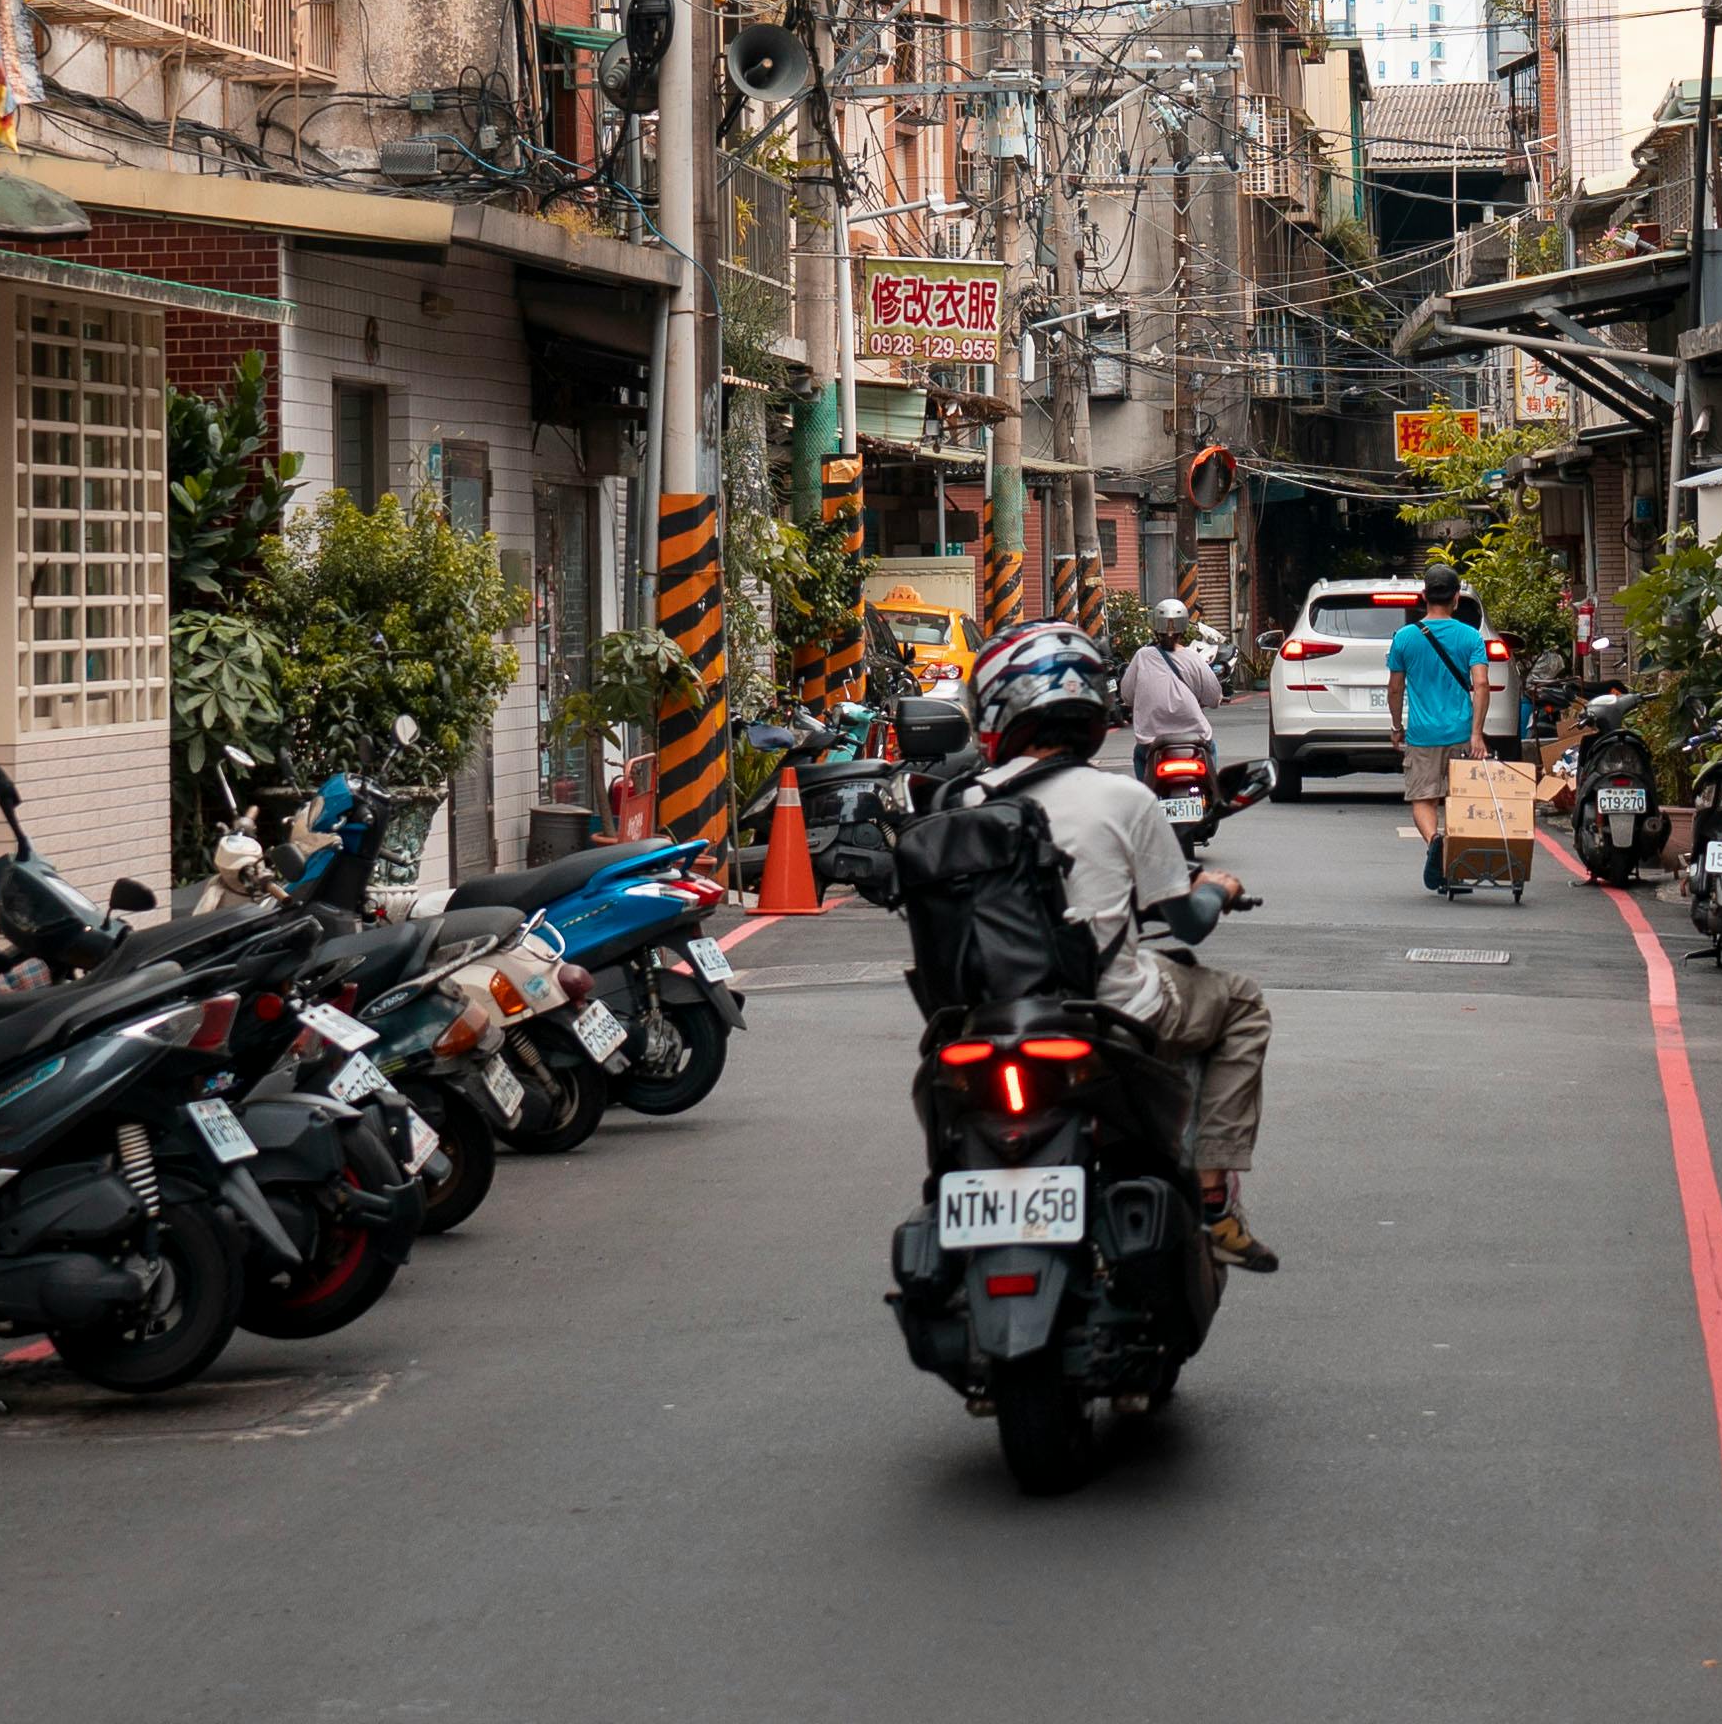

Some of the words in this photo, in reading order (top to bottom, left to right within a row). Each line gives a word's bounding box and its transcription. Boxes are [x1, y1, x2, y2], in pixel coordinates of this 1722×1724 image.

[871, 274, 997, 332] 修改衣服
[869, 332, 997, 361] 0928-129-955
[891, 592, 917, 601] TAXI
